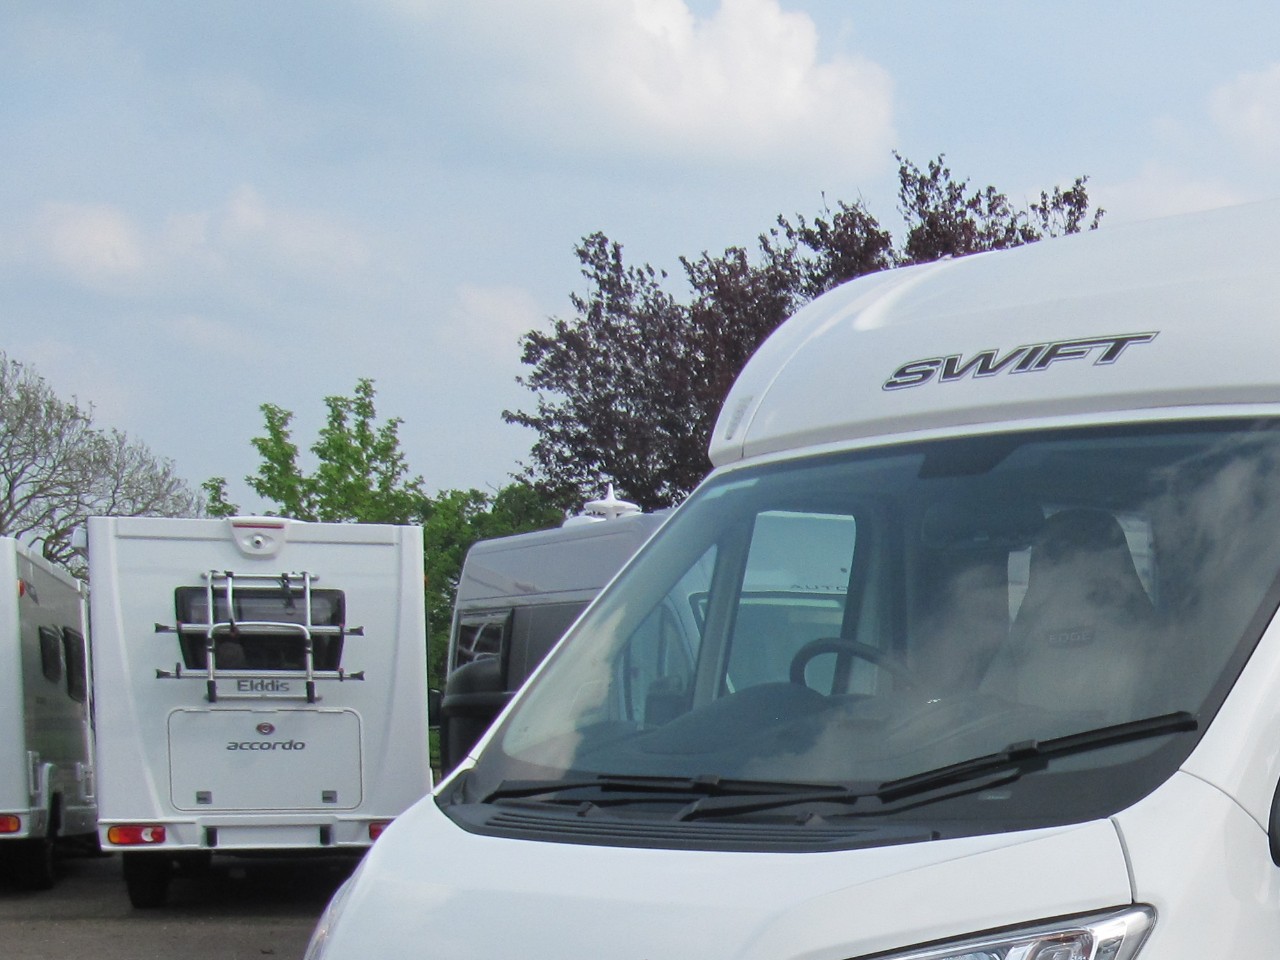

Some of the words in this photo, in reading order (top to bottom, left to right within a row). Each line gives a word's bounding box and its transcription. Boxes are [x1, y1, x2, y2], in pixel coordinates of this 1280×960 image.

[882, 331, 1160, 391] SWIFT
[236, 679, 290, 692] Elddis
[226, 740, 306, 751] accordo
